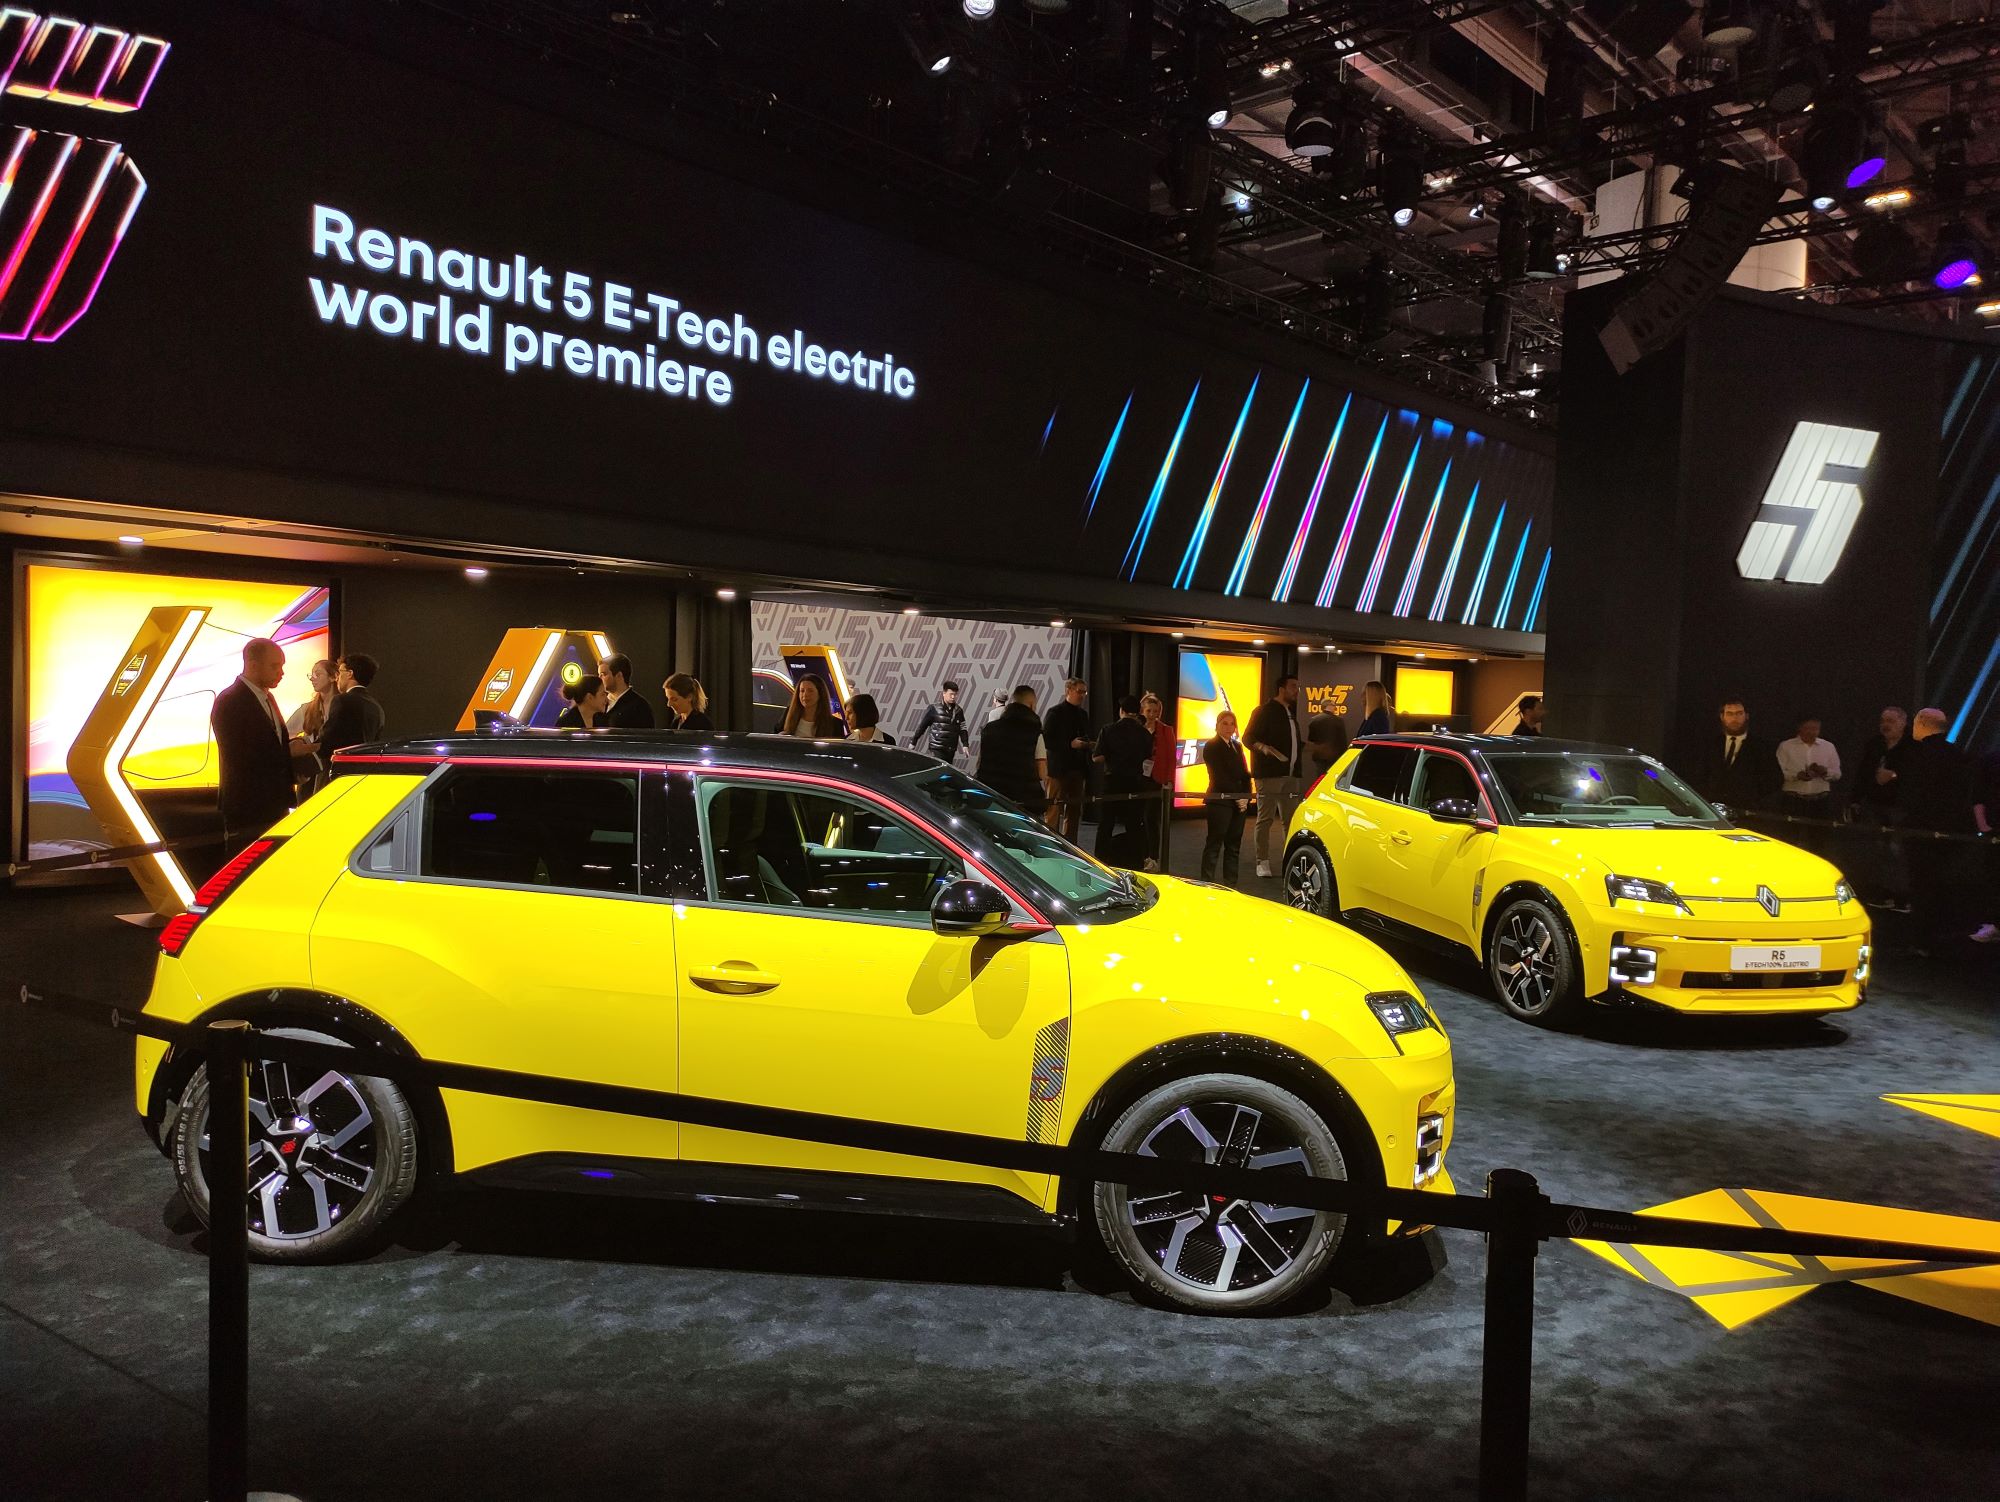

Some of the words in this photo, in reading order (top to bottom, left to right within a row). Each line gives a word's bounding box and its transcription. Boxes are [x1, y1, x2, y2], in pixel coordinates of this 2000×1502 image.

[308, 277, 490, 354] world
[504, 322, 733, 407] premiere
[312, 204, 552, 312] Renault
[562, 271, 592, 320] 5
[604, 281, 758, 362] E-Tech
[767, 329, 917, 400] electric
[1736, 421, 1880, 584] 5
[1308, 702, 1348, 716] louge
[1771, 950, 1785, 960] R5
[177, 1144, 187, 1175] 195/55
